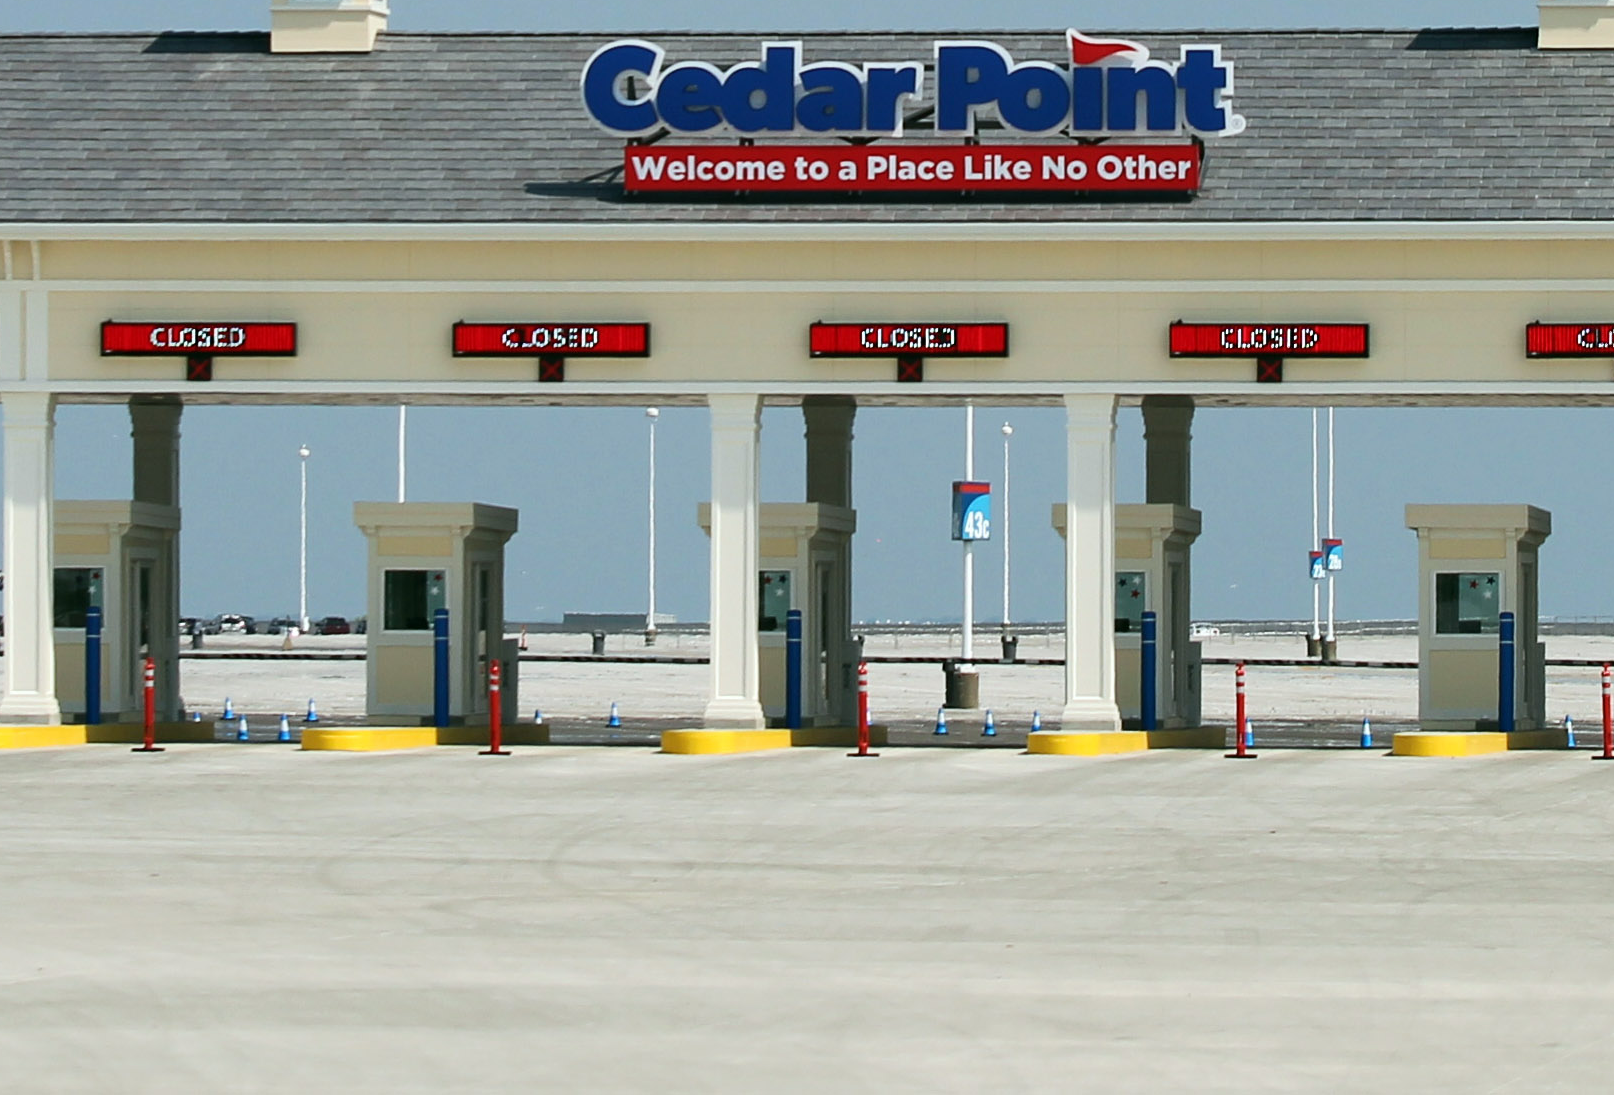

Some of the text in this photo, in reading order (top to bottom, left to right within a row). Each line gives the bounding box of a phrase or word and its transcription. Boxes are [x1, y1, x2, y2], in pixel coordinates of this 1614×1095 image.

[583, 39, 1231, 135] Cedar Point
[631, 154, 1192, 181] Welcome to a Place Like No Other
[150, 328, 246, 348] CLOSED
[502, 328, 598, 349] CLOSED
[861, 328, 955, 349] CLOSED
[1221, 328, 1318, 349] CLOSED
